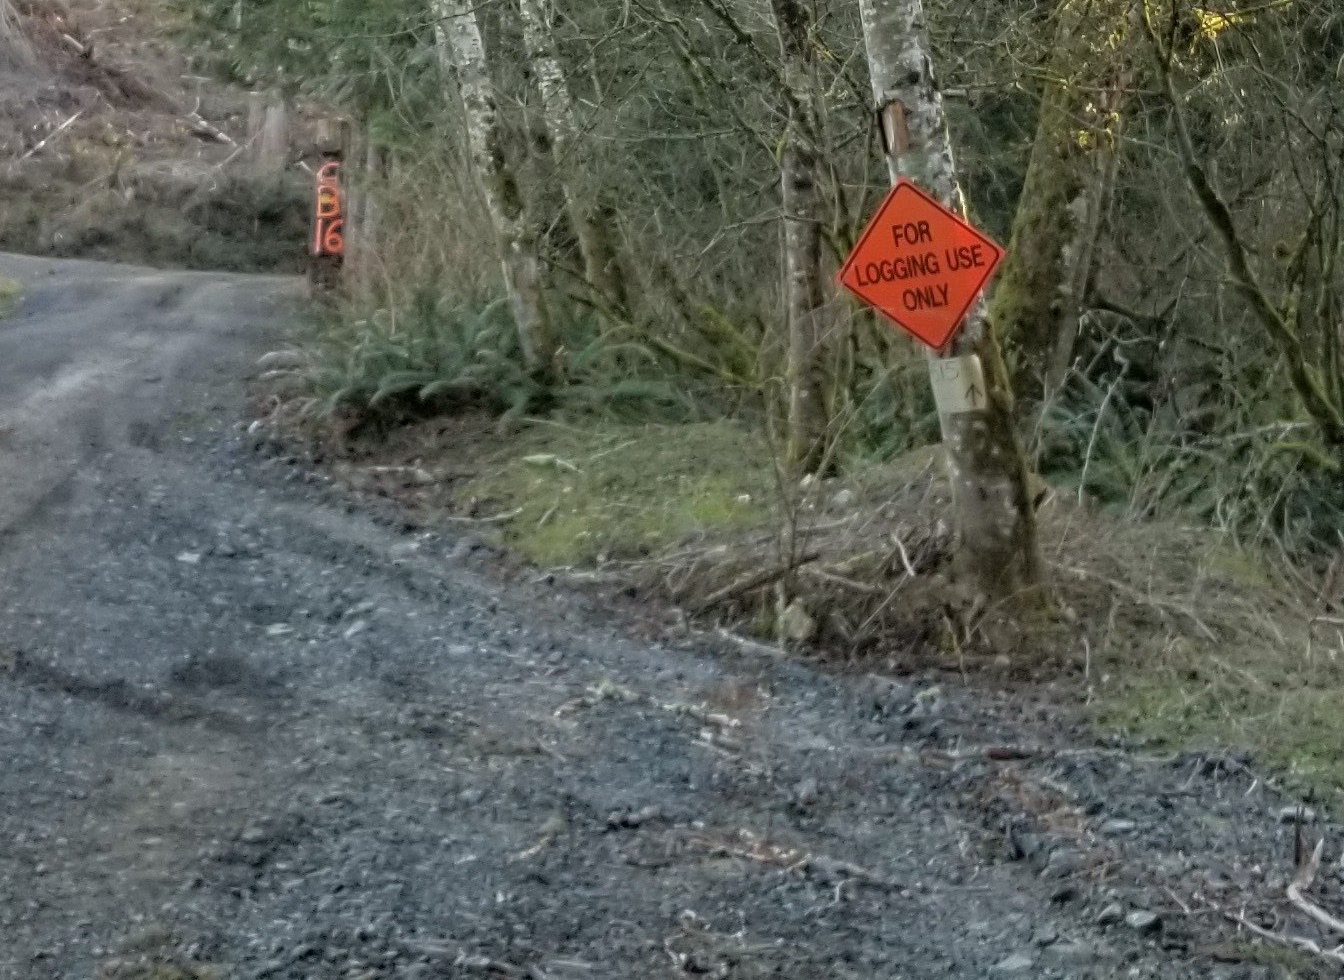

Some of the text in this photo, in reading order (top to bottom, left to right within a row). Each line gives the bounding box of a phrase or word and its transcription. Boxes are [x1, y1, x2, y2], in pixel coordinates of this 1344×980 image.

[892, 222, 932, 247] FOR
[855, 246, 984, 286] LOGGING USE
[903, 285, 949, 310] ONLY
